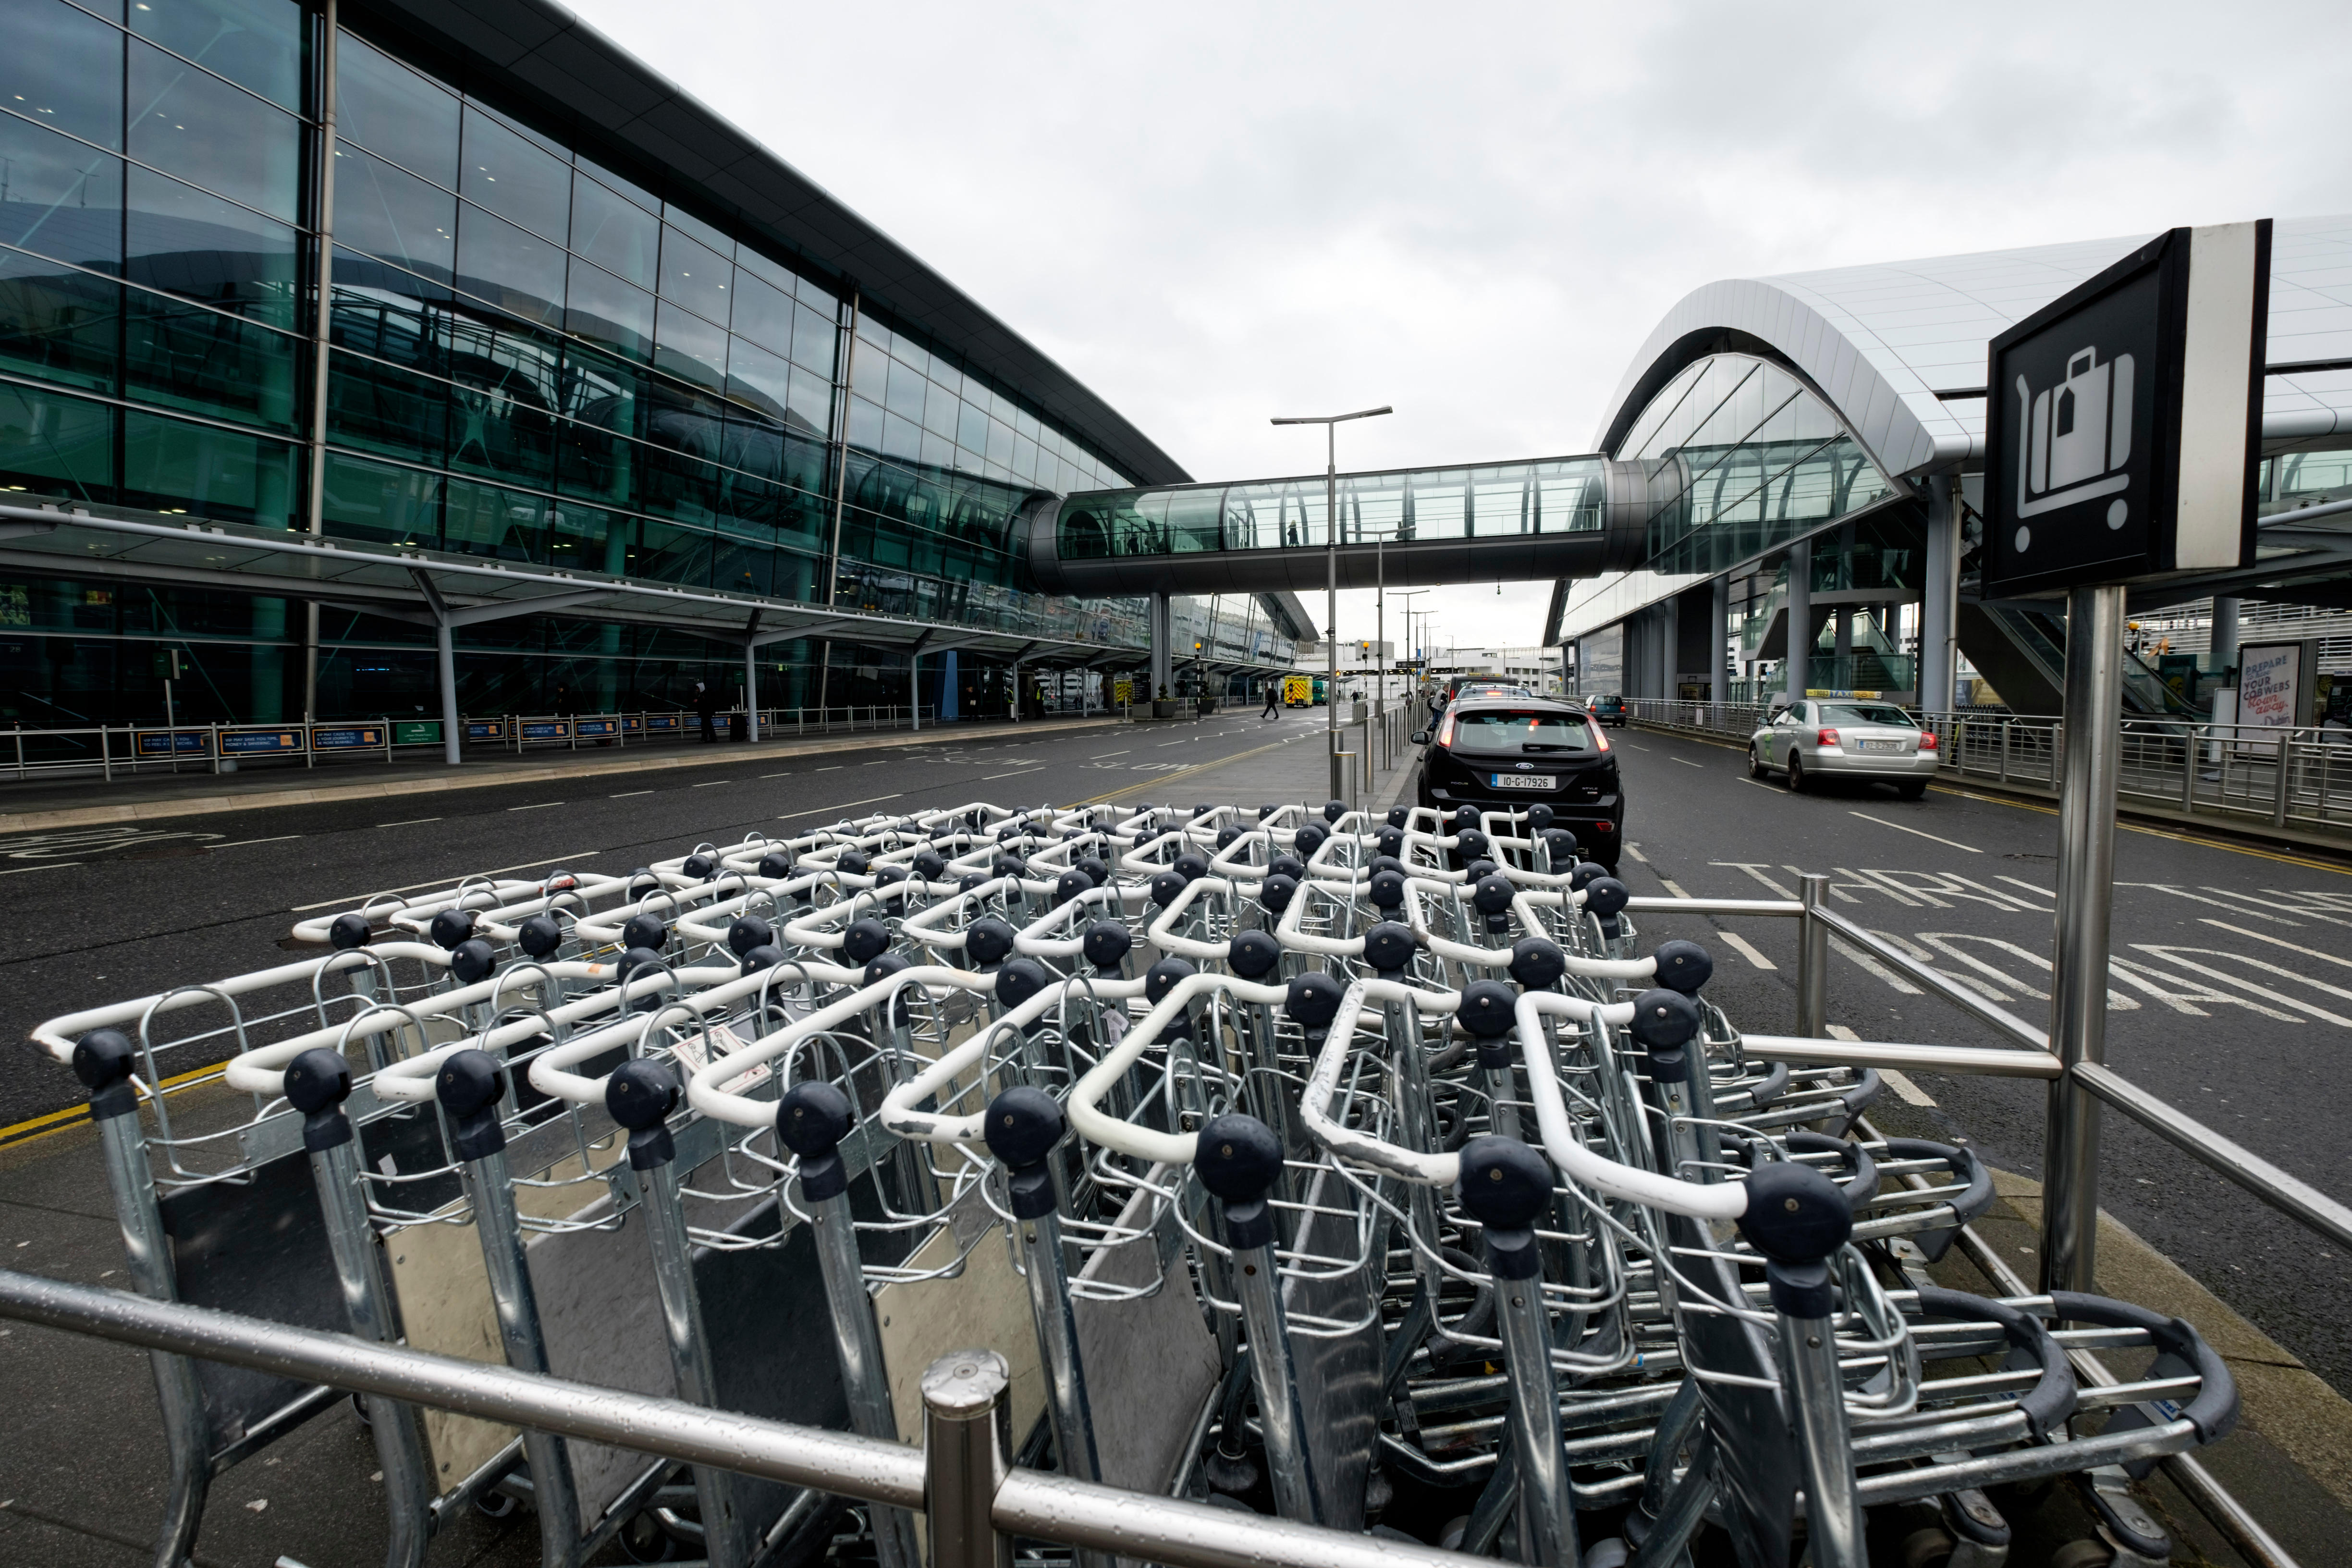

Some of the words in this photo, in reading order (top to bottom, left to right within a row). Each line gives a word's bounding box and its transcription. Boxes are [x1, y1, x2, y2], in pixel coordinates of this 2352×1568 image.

[2245, 655, 2287, 675] PREPARE
[2243, 676, 2271, 691] YOUR
[2243, 680, 2291, 700] COBWEBS
[2248, 694, 2278, 709] blown
[2255, 700, 2289, 715] away.
[925, 756, 1048, 766] SLOW
[1078, 761, 1200, 771] SLOW
[1503, 777, 1548, 787] 10-G-17926
